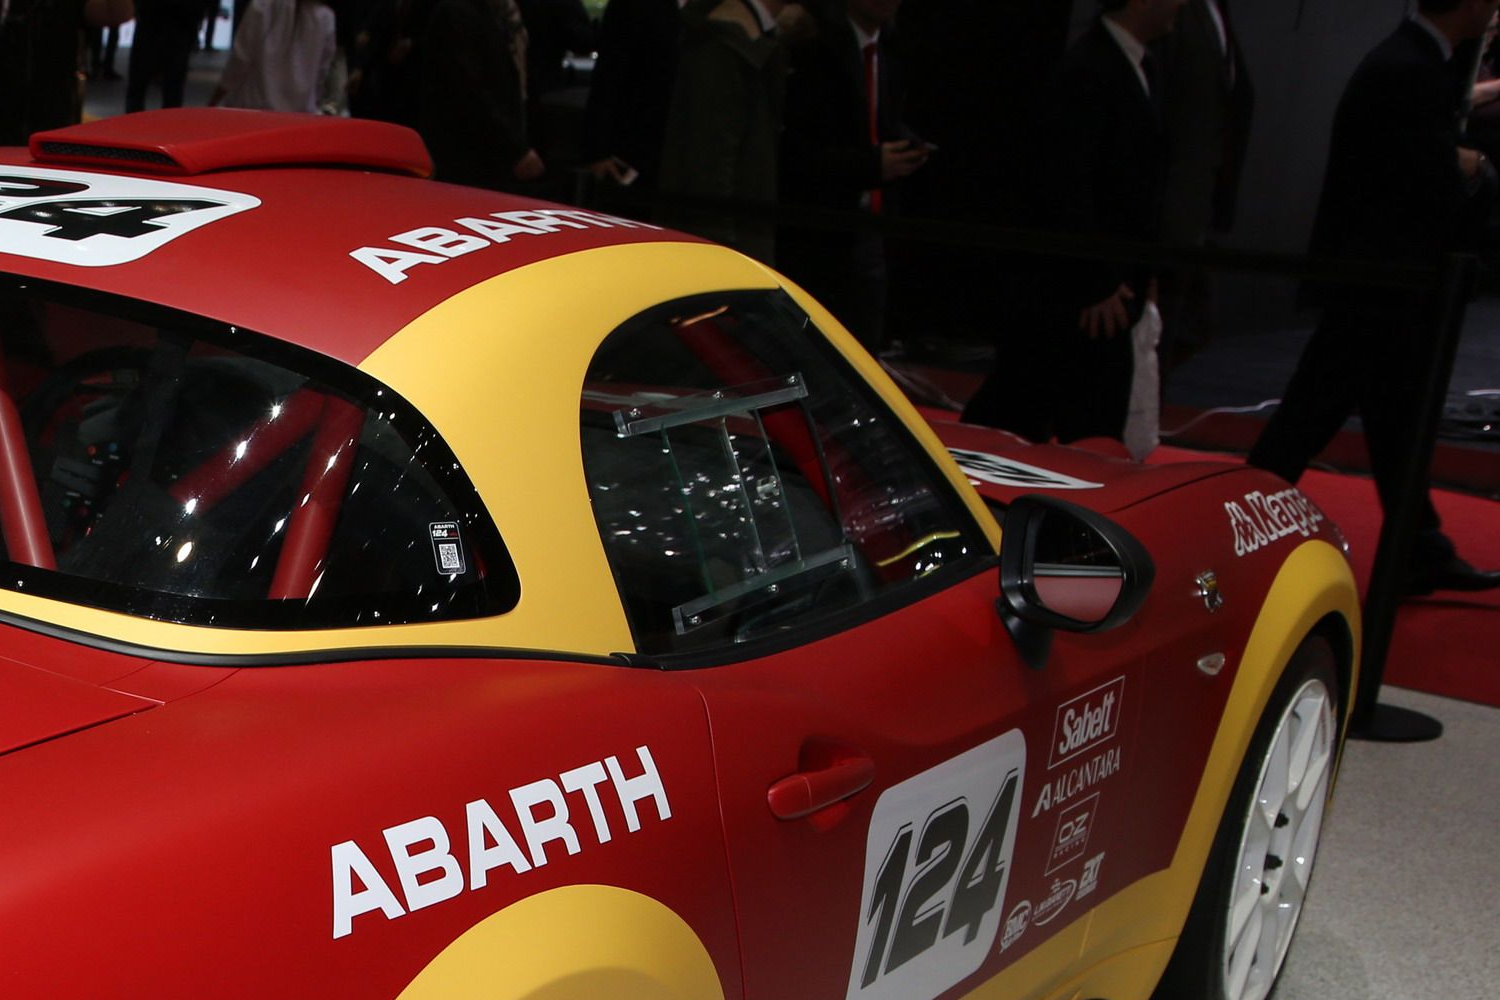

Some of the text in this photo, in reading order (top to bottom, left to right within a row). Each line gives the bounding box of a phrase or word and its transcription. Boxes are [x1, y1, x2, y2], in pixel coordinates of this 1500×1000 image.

[349, 208, 666, 285] ABARTH
[1058, 691, 1115, 755] Sabelt
[1052, 746, 1121, 807] ALCANTARA
[331, 745, 672, 939] ABARTH
[1059, 812, 1090, 843] OZ
[860, 768, 1019, 990] 124
